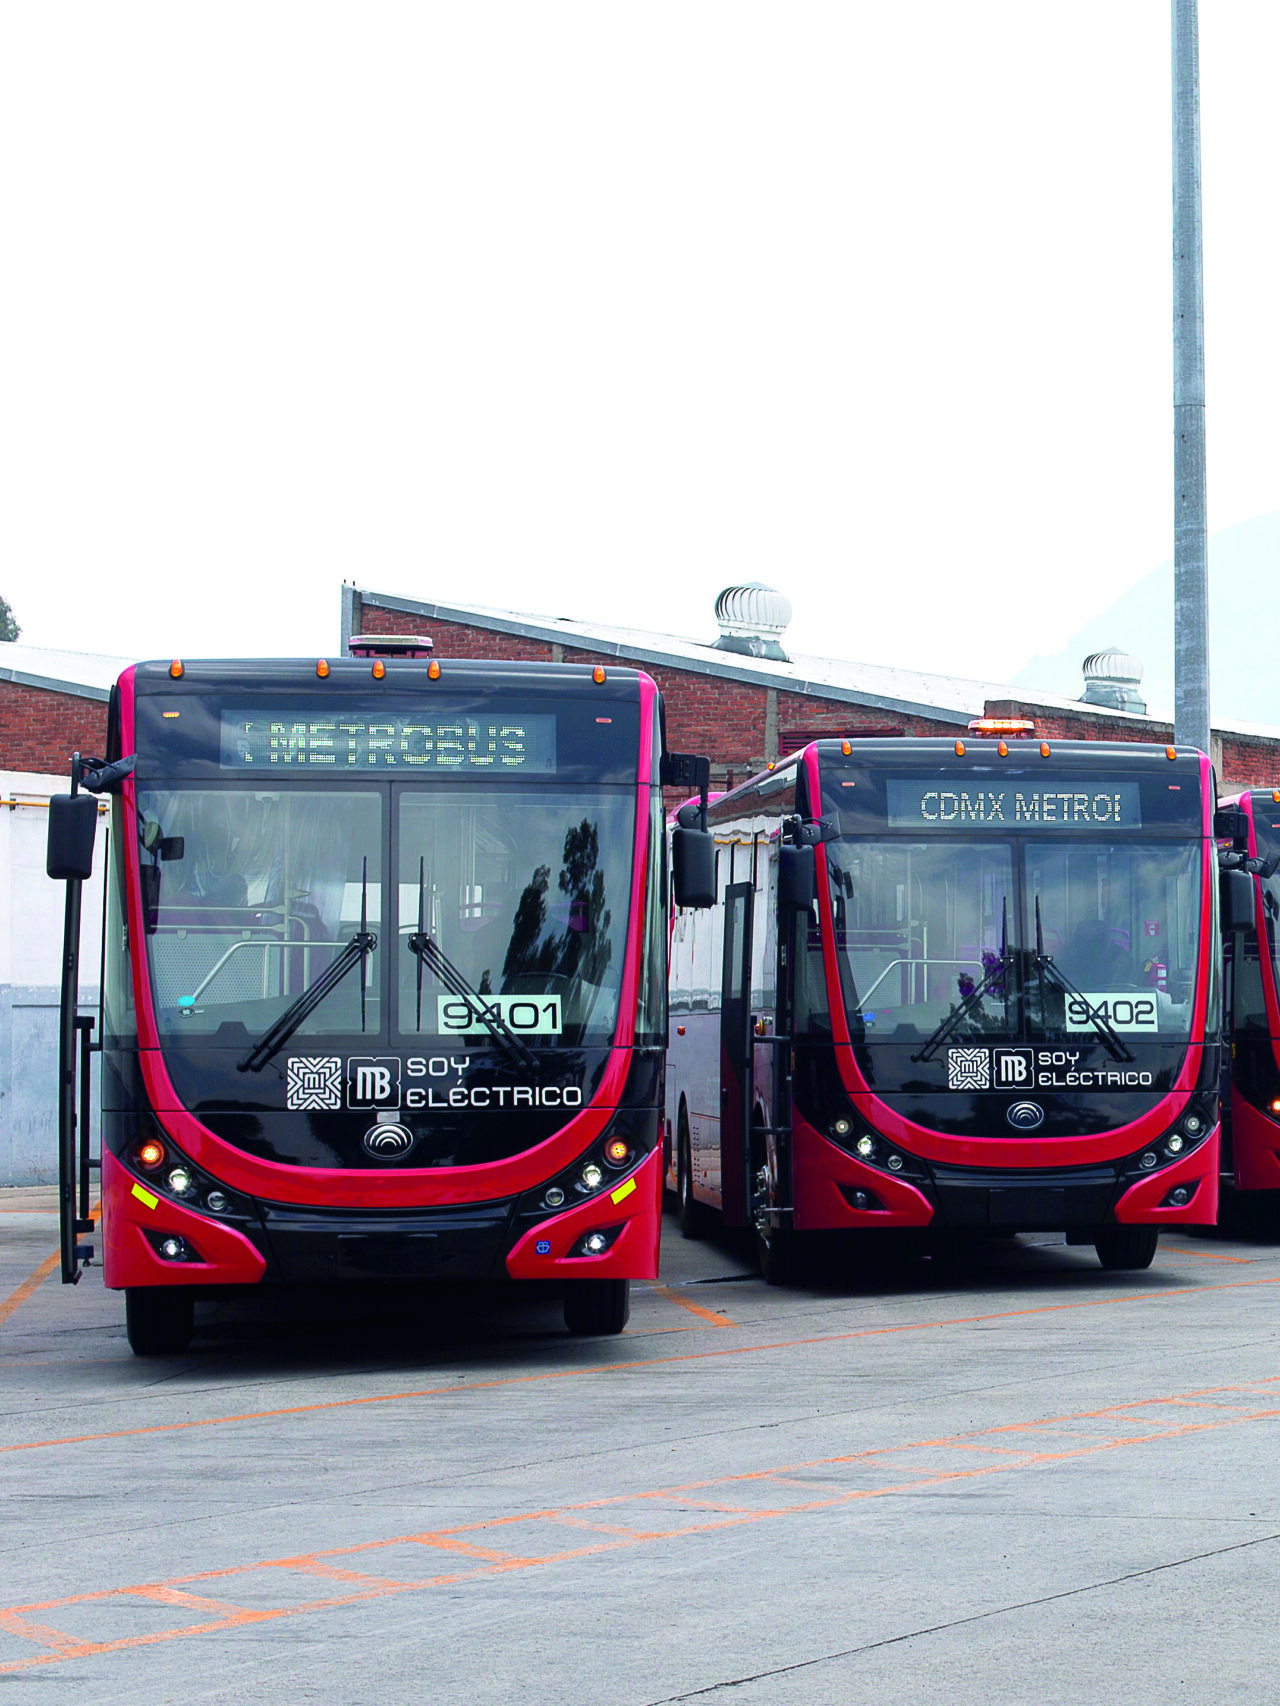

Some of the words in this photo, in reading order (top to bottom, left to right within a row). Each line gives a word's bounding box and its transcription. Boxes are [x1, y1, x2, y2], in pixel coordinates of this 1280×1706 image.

[270, 722, 525, 766] METROBUS
[921, 792, 1004, 821] CDMX
[442, 1002, 558, 1030] 9401
[1068, 1000, 1155, 1024] 9402
[406, 1056, 470, 1077] SOY
[1000, 1055, 1028, 1082] MB
[1038, 1052, 1080, 1066] SOY
[356, 1066, 392, 1100] MB
[1038, 1067, 1152, 1086] ELÉCTRICO
[406, 1080, 582, 1108] ELÉCTRICO
